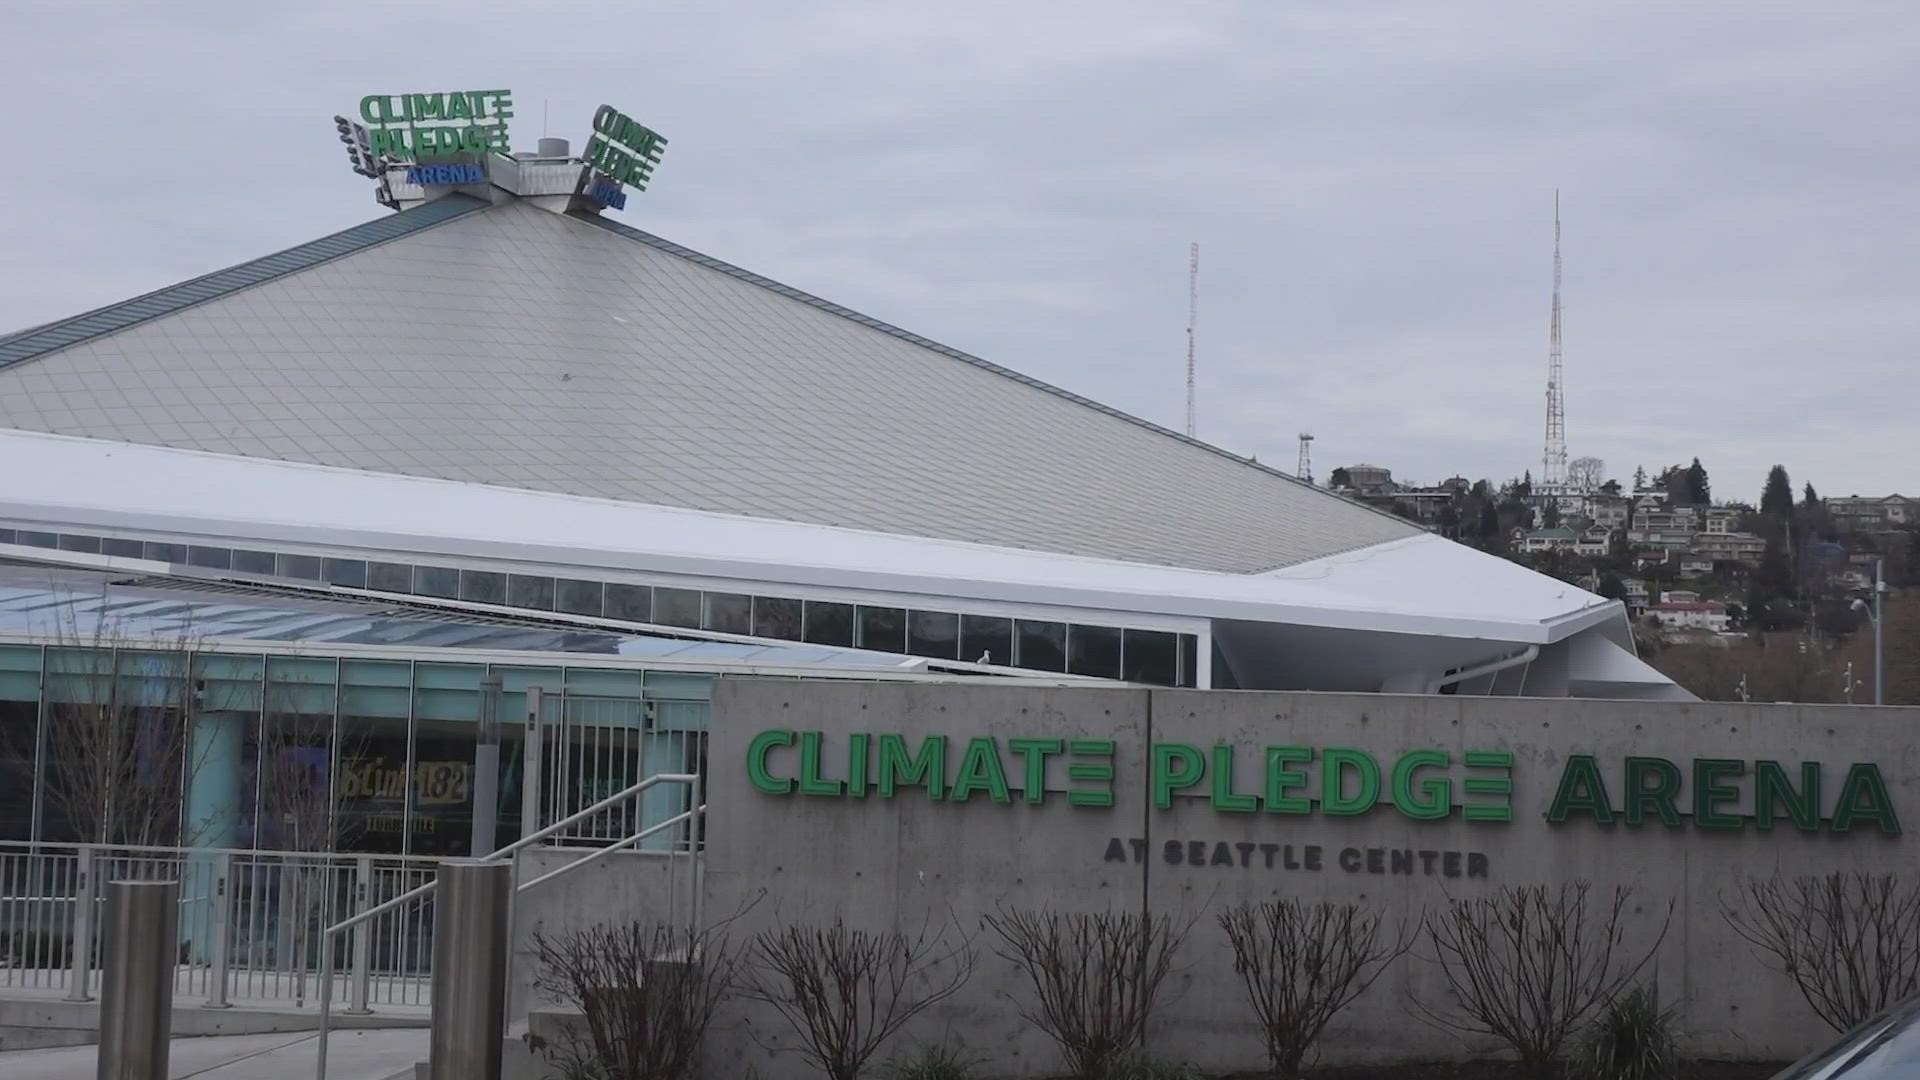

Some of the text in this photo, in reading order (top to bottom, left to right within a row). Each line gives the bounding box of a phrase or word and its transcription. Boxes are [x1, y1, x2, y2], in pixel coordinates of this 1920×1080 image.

[360, 89, 513, 124] CLIMATE
[370, 122, 510, 157] PLEDGE
[406, 163, 483, 185] ARENA
[746, 730, 1902, 834] CLIMATE PLEDGE ARENA
[1104, 838, 1489, 877] AT SEATTLE CENTER
